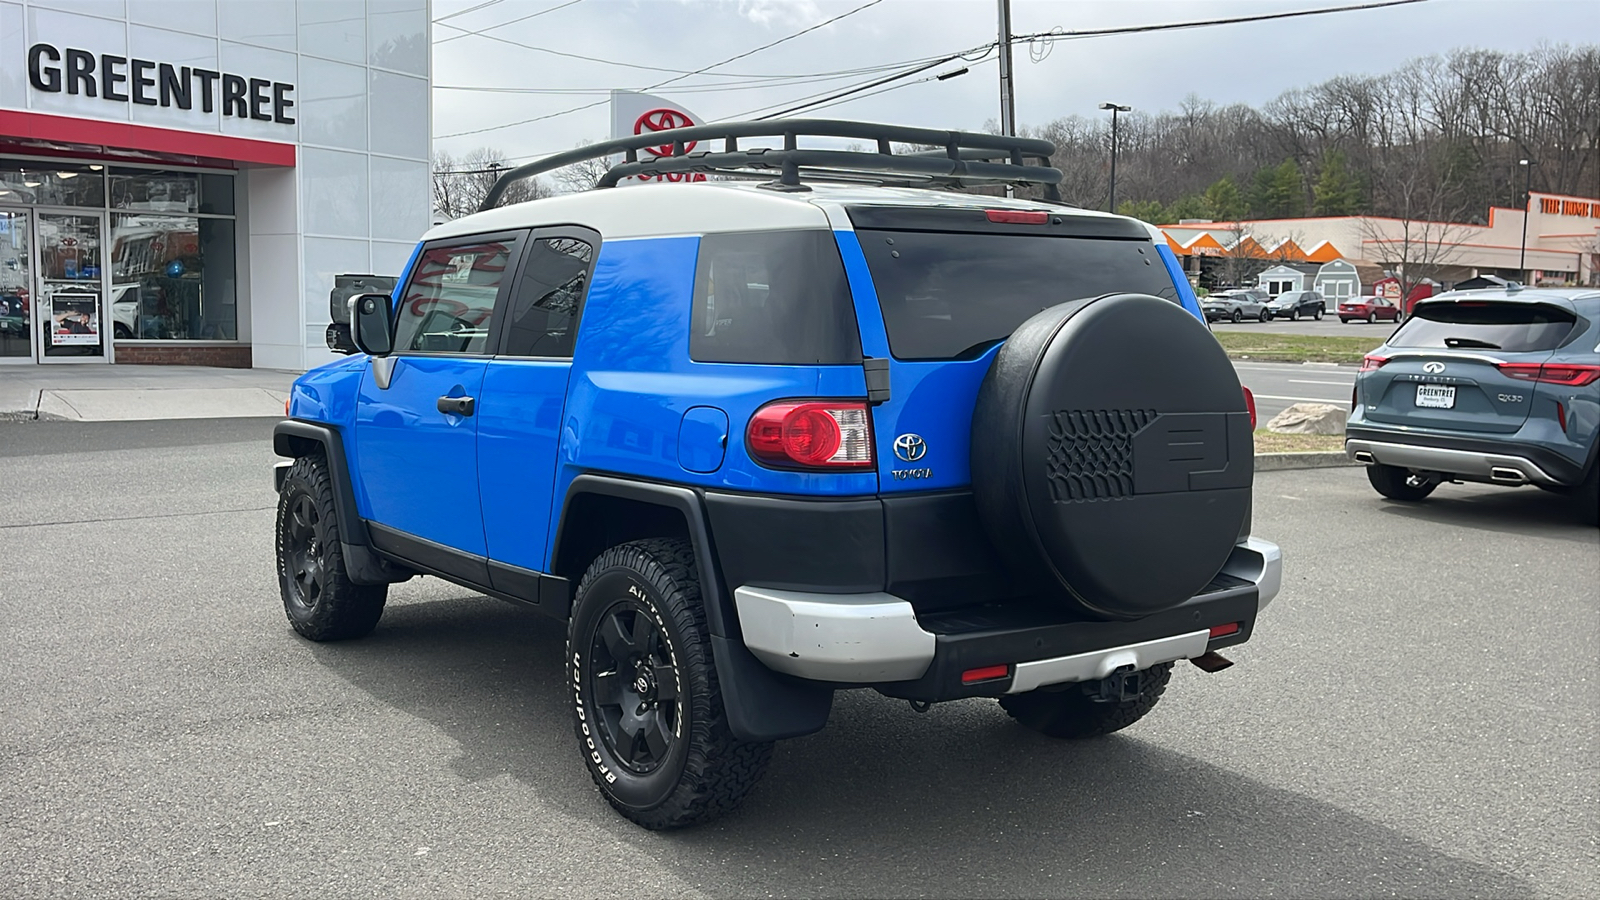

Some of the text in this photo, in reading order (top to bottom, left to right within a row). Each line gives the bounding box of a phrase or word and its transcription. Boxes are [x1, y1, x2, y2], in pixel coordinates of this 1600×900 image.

[28, 43, 296, 125] GREENTREE
[1540, 198, 1560, 214] THE
[1562, 200, 1589, 217] HOME
[1418, 387, 1454, 398] GREENTREE
[891, 468, 933, 480] TOYOTA
[628, 584, 682, 693] All-Terrain
[573, 652, 617, 784] BFGoodrich
